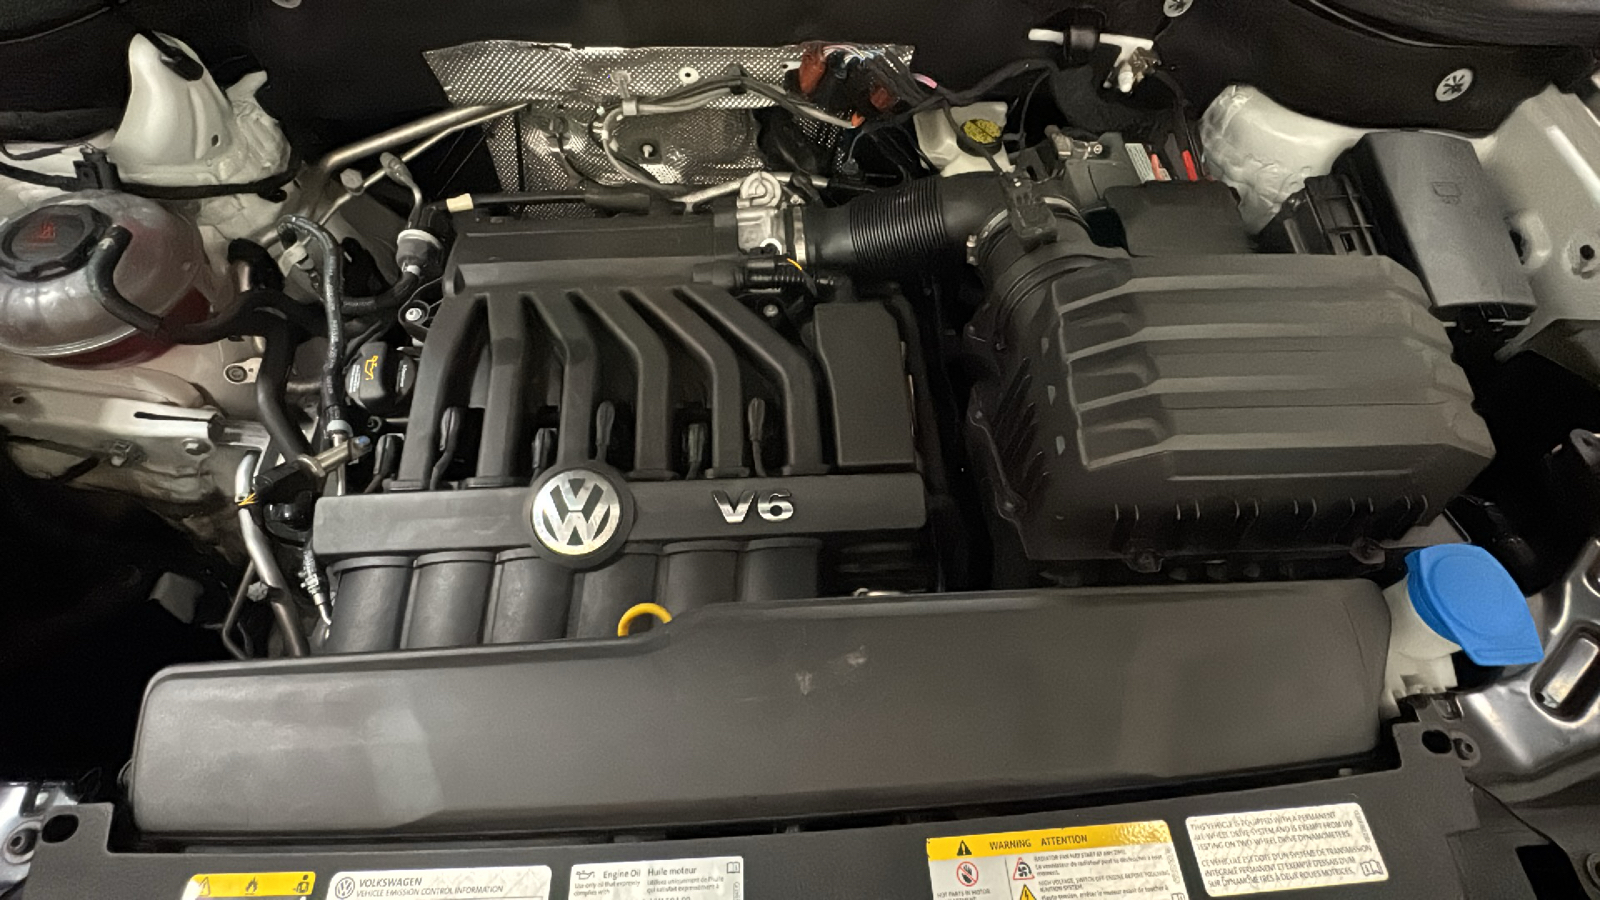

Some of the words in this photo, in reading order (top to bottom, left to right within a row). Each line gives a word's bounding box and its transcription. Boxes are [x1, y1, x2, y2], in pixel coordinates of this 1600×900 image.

[711, 489, 794, 523] V6
[1206, 821, 1232, 829] VEHICLE
[1241, 817, 1273, 827] EQUIPPED
[1274, 815, 1292, 823] WITH
[1298, 811, 1336, 821] PERMANENT
[1230, 829, 1251, 838] DRIVE
[1250, 827, 1275, 835] SYSTEM
[1297, 822, 1322, 831] EXEMPT
[1323, 821, 1342, 829] FROM
[989, 839, 1032, 851] WARNING
[1041, 834, 1088, 846] ATTENTION
[1197, 841, 1224, 851] TESTING
[1278, 835, 1297, 843] DRIVE
[1201, 859, 1210, 867] CE
[1242, 855, 1253, 863] EST
[1316, 848, 1326, 856] DE
[1326, 845, 1372, 855] TRANSMISSION
[603, 870, 629, 880] Engine
[631, 869, 641, 877] Oil
[647, 867, 667, 876] Huile
[669, 867, 697, 875] moteur
[1208, 879, 1221, 887] SUR
[1300, 870, 1321, 879] ROUES
[359, 877, 422, 888] VOLKSWAGEN
[356, 889, 384, 898] VEHICLE
[385, 888, 419, 897] EMISSION
[421, 886, 453, 896] CONTROL
[454, 885, 503, 894] INFORMATION
[647, 887, 655, 895] qui
